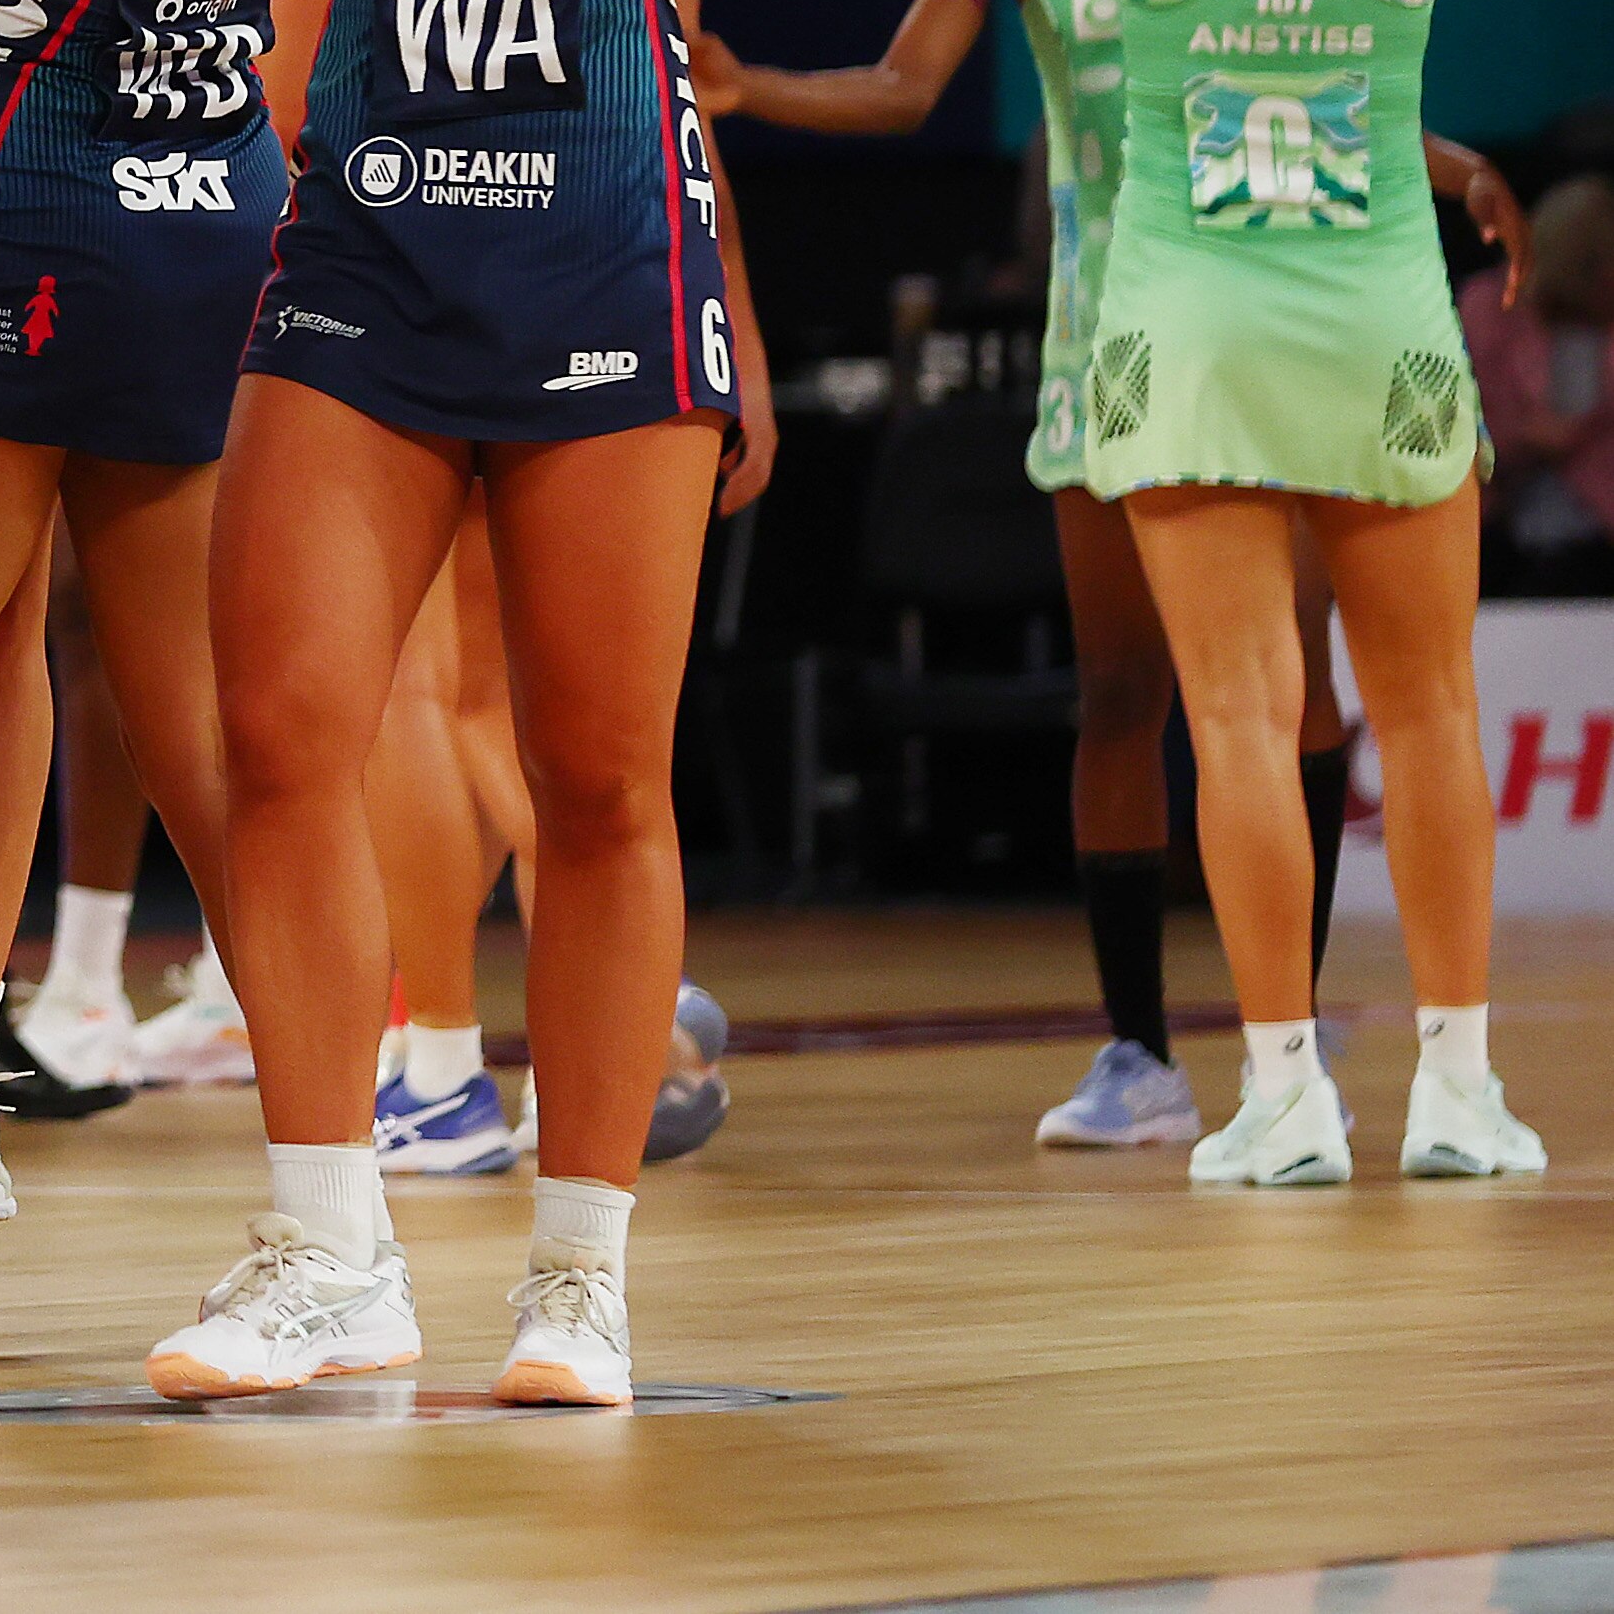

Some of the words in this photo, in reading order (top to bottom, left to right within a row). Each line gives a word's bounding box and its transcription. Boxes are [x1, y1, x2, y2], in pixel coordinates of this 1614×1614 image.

[1188, 23, 1374, 55] ANSTISS
[424, 148, 556, 187] DEAKIN
[422, 185, 554, 209] UNIVERSITY
[293, 311, 366, 336] VICTORIAN
[701, 298, 731, 396] 6
[570, 351, 639, 375] BMD
